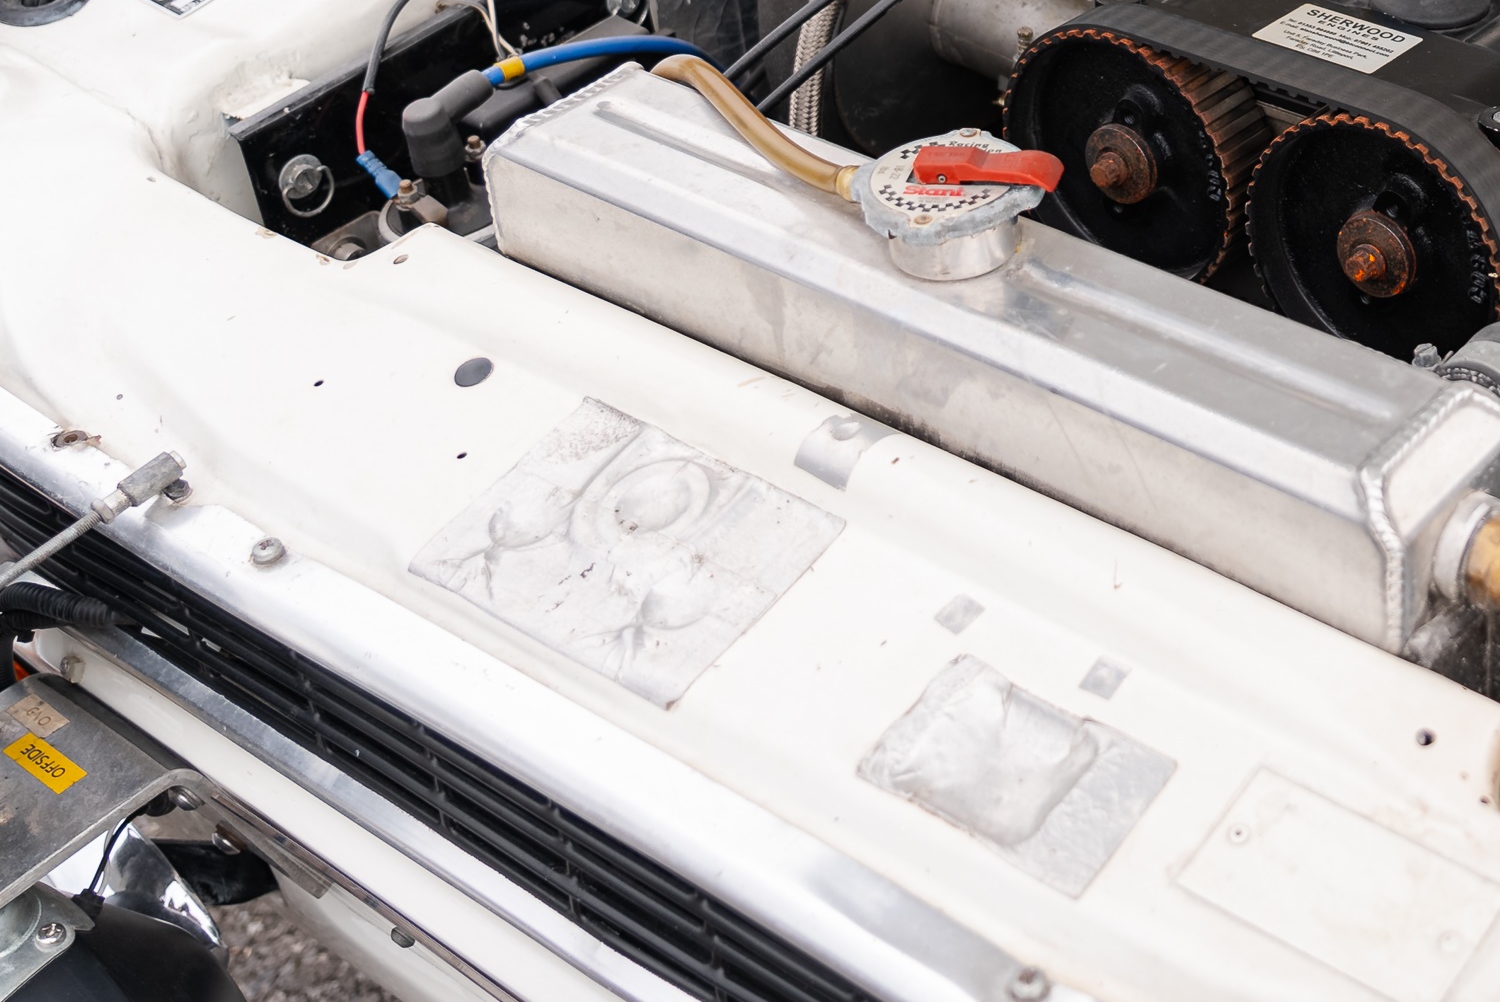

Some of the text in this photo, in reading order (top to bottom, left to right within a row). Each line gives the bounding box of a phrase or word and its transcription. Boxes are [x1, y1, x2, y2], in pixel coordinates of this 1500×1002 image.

[1306, 8, 1406, 43] SHERWOOD
[1317, 20, 1380, 42] ENGINES
[903, 185, 964, 197] Stant
[20, 743, 66, 778] OFFSIDE
